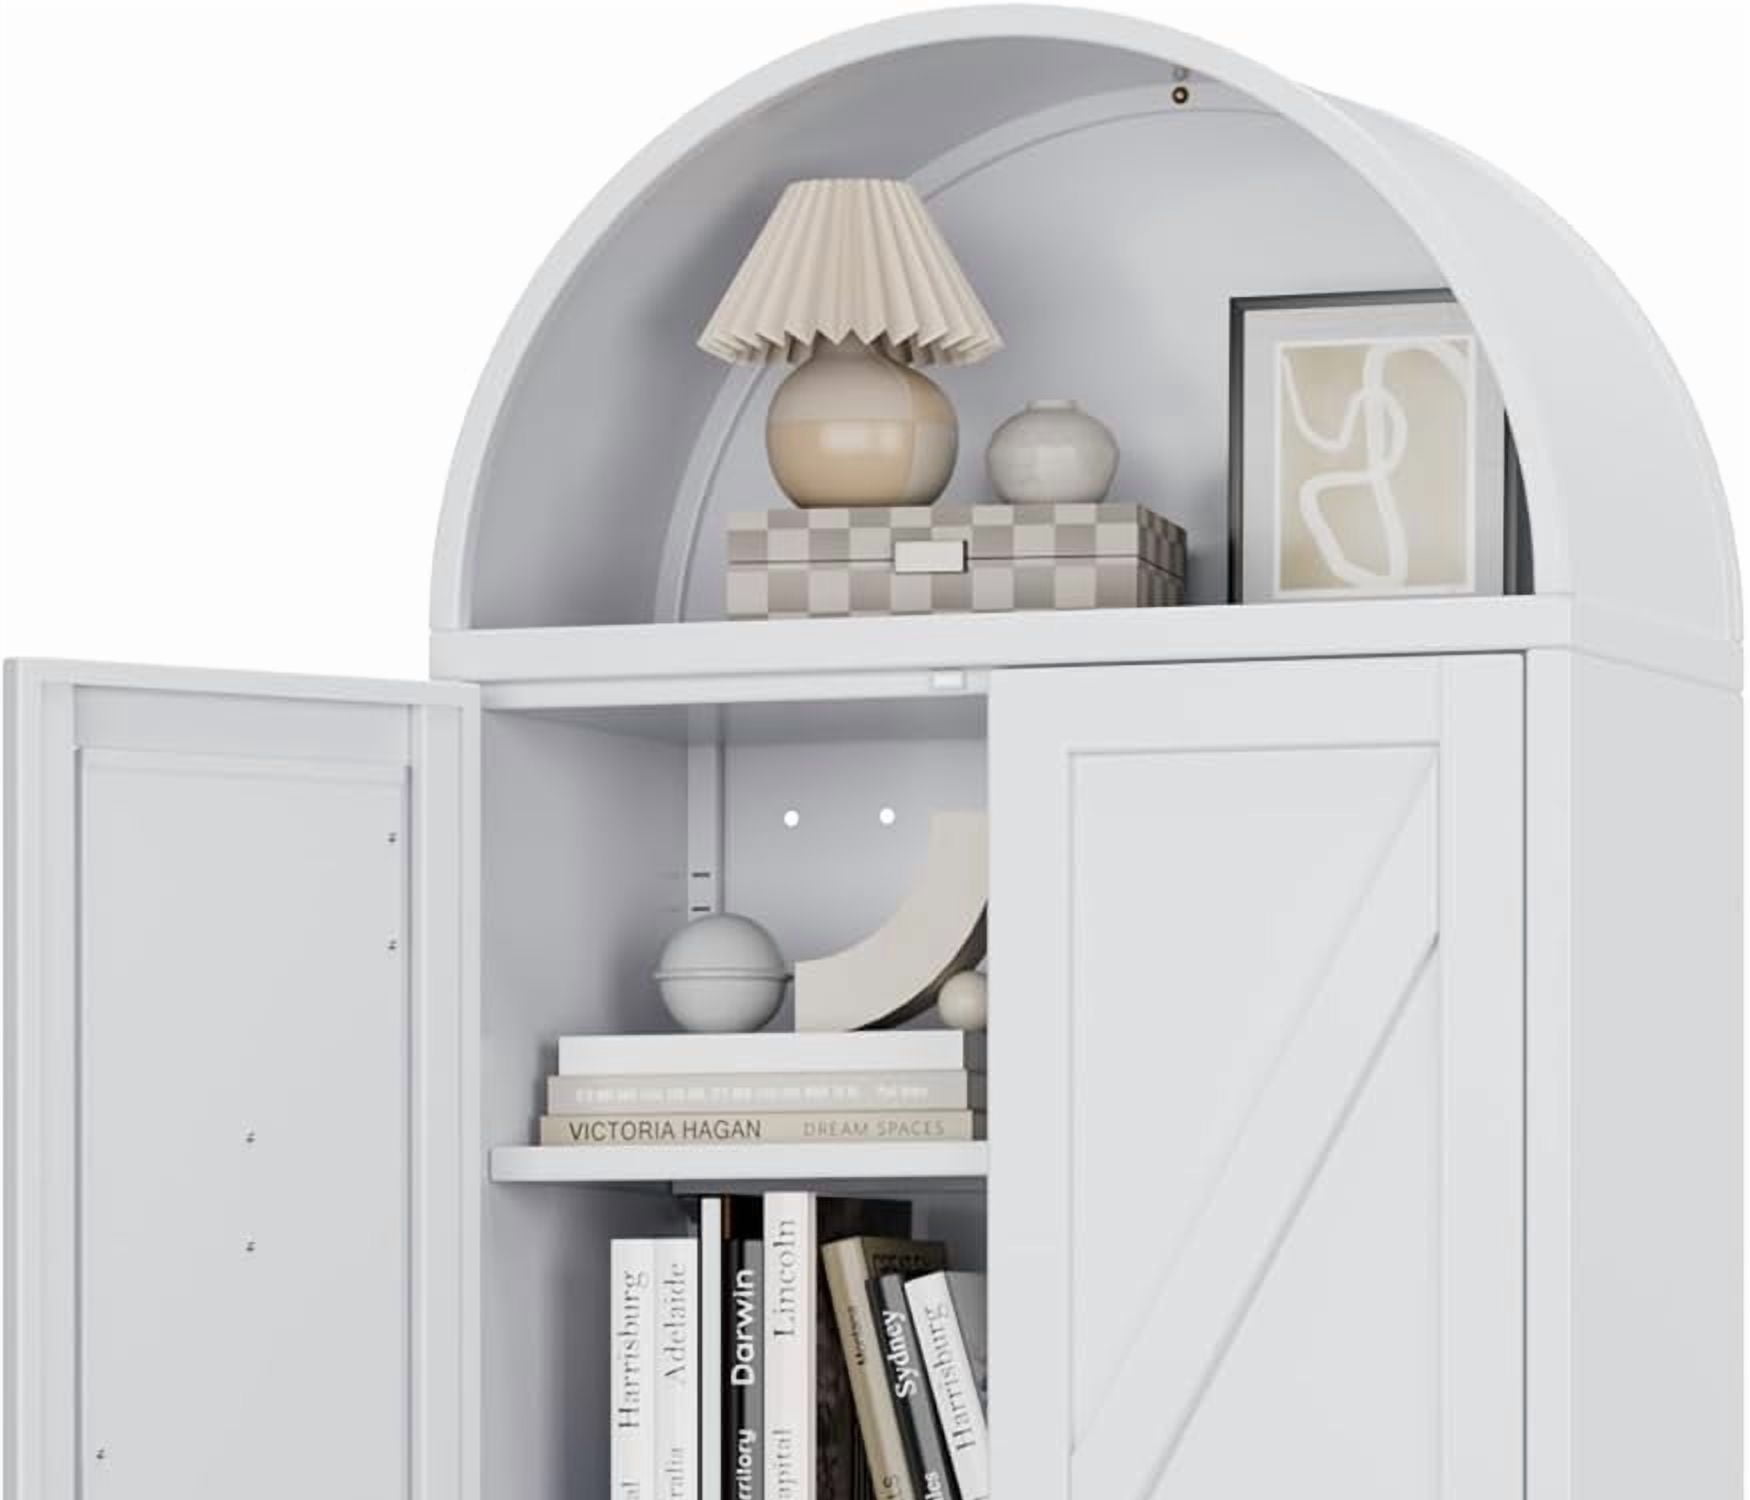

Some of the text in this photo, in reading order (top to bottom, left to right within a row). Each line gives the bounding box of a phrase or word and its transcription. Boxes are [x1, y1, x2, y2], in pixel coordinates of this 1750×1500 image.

[568, 1119, 762, 1143] VICTORIA HAGAN
[803, 1119, 945, 1138] DREAM SPACES
[662, 1262, 687, 1381] Adelaide
[730, 1268, 755, 1387] Darwin
[773, 1218, 796, 1339] Lincoln
[618, 1270, 649, 1429] Harrisburg
[882, 1310, 919, 1399] Sydney
[924, 1304, 976, 1451] Harrisburg
